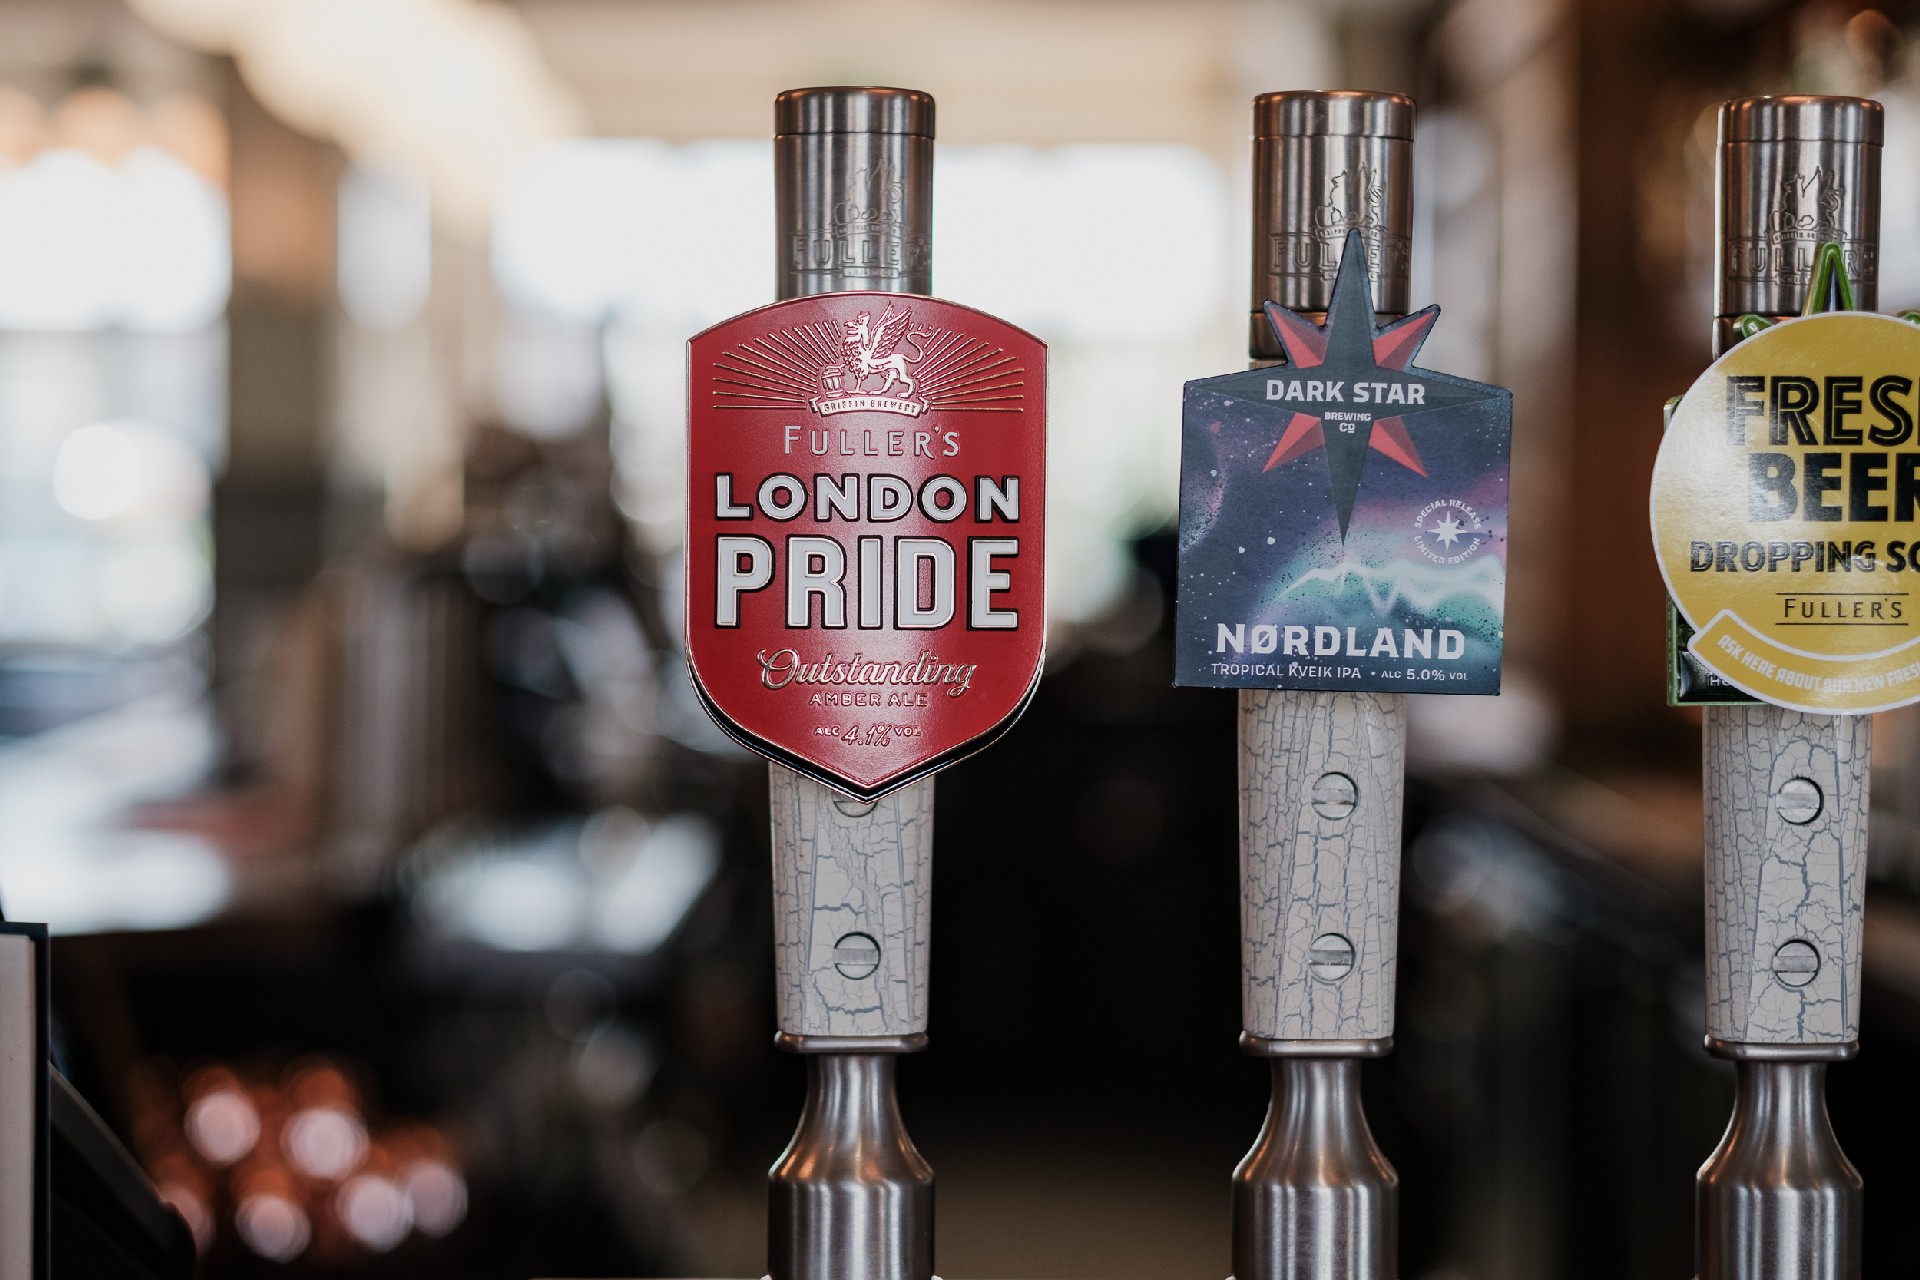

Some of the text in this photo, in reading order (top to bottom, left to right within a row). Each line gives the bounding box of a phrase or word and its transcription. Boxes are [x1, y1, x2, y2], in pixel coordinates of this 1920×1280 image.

[1266, 379, 1425, 405] DARK STAR
[1324, 411, 1371, 422] BREWING
[1725, 375, 1920, 447] FRES
[784, 425, 960, 459] FULLER'S
[714, 472, 1020, 523] LONDON
[1414, 499, 1482, 530] SPECIAL RELEASE
[1413, 535, 1481, 565] LIMITED EDITION
[1689, 540, 1877, 574] DROPPING
[715, 533, 1019, 631] PRIDE
[1783, 597, 1903, 620] FULLER'S
[1216, 622, 1466, 661] NØRDLAND
[757, 648, 977, 697] Outstanding
[1211, 663, 1469, 681] TROPICAL KVEIK IPA ALC 5.0% VOL
[1717, 634, 1746, 660] ASK
[1741, 651, 1777, 679] HERE
[1775, 668, 1823, 691] ABOUT
[1855, 674, 1885, 693] NEW
[1886, 661, 1920, 687] FRES
[809, 692, 928, 707] AMBER ALE
[814, 724, 922, 747] ALC 4.1% VOL
